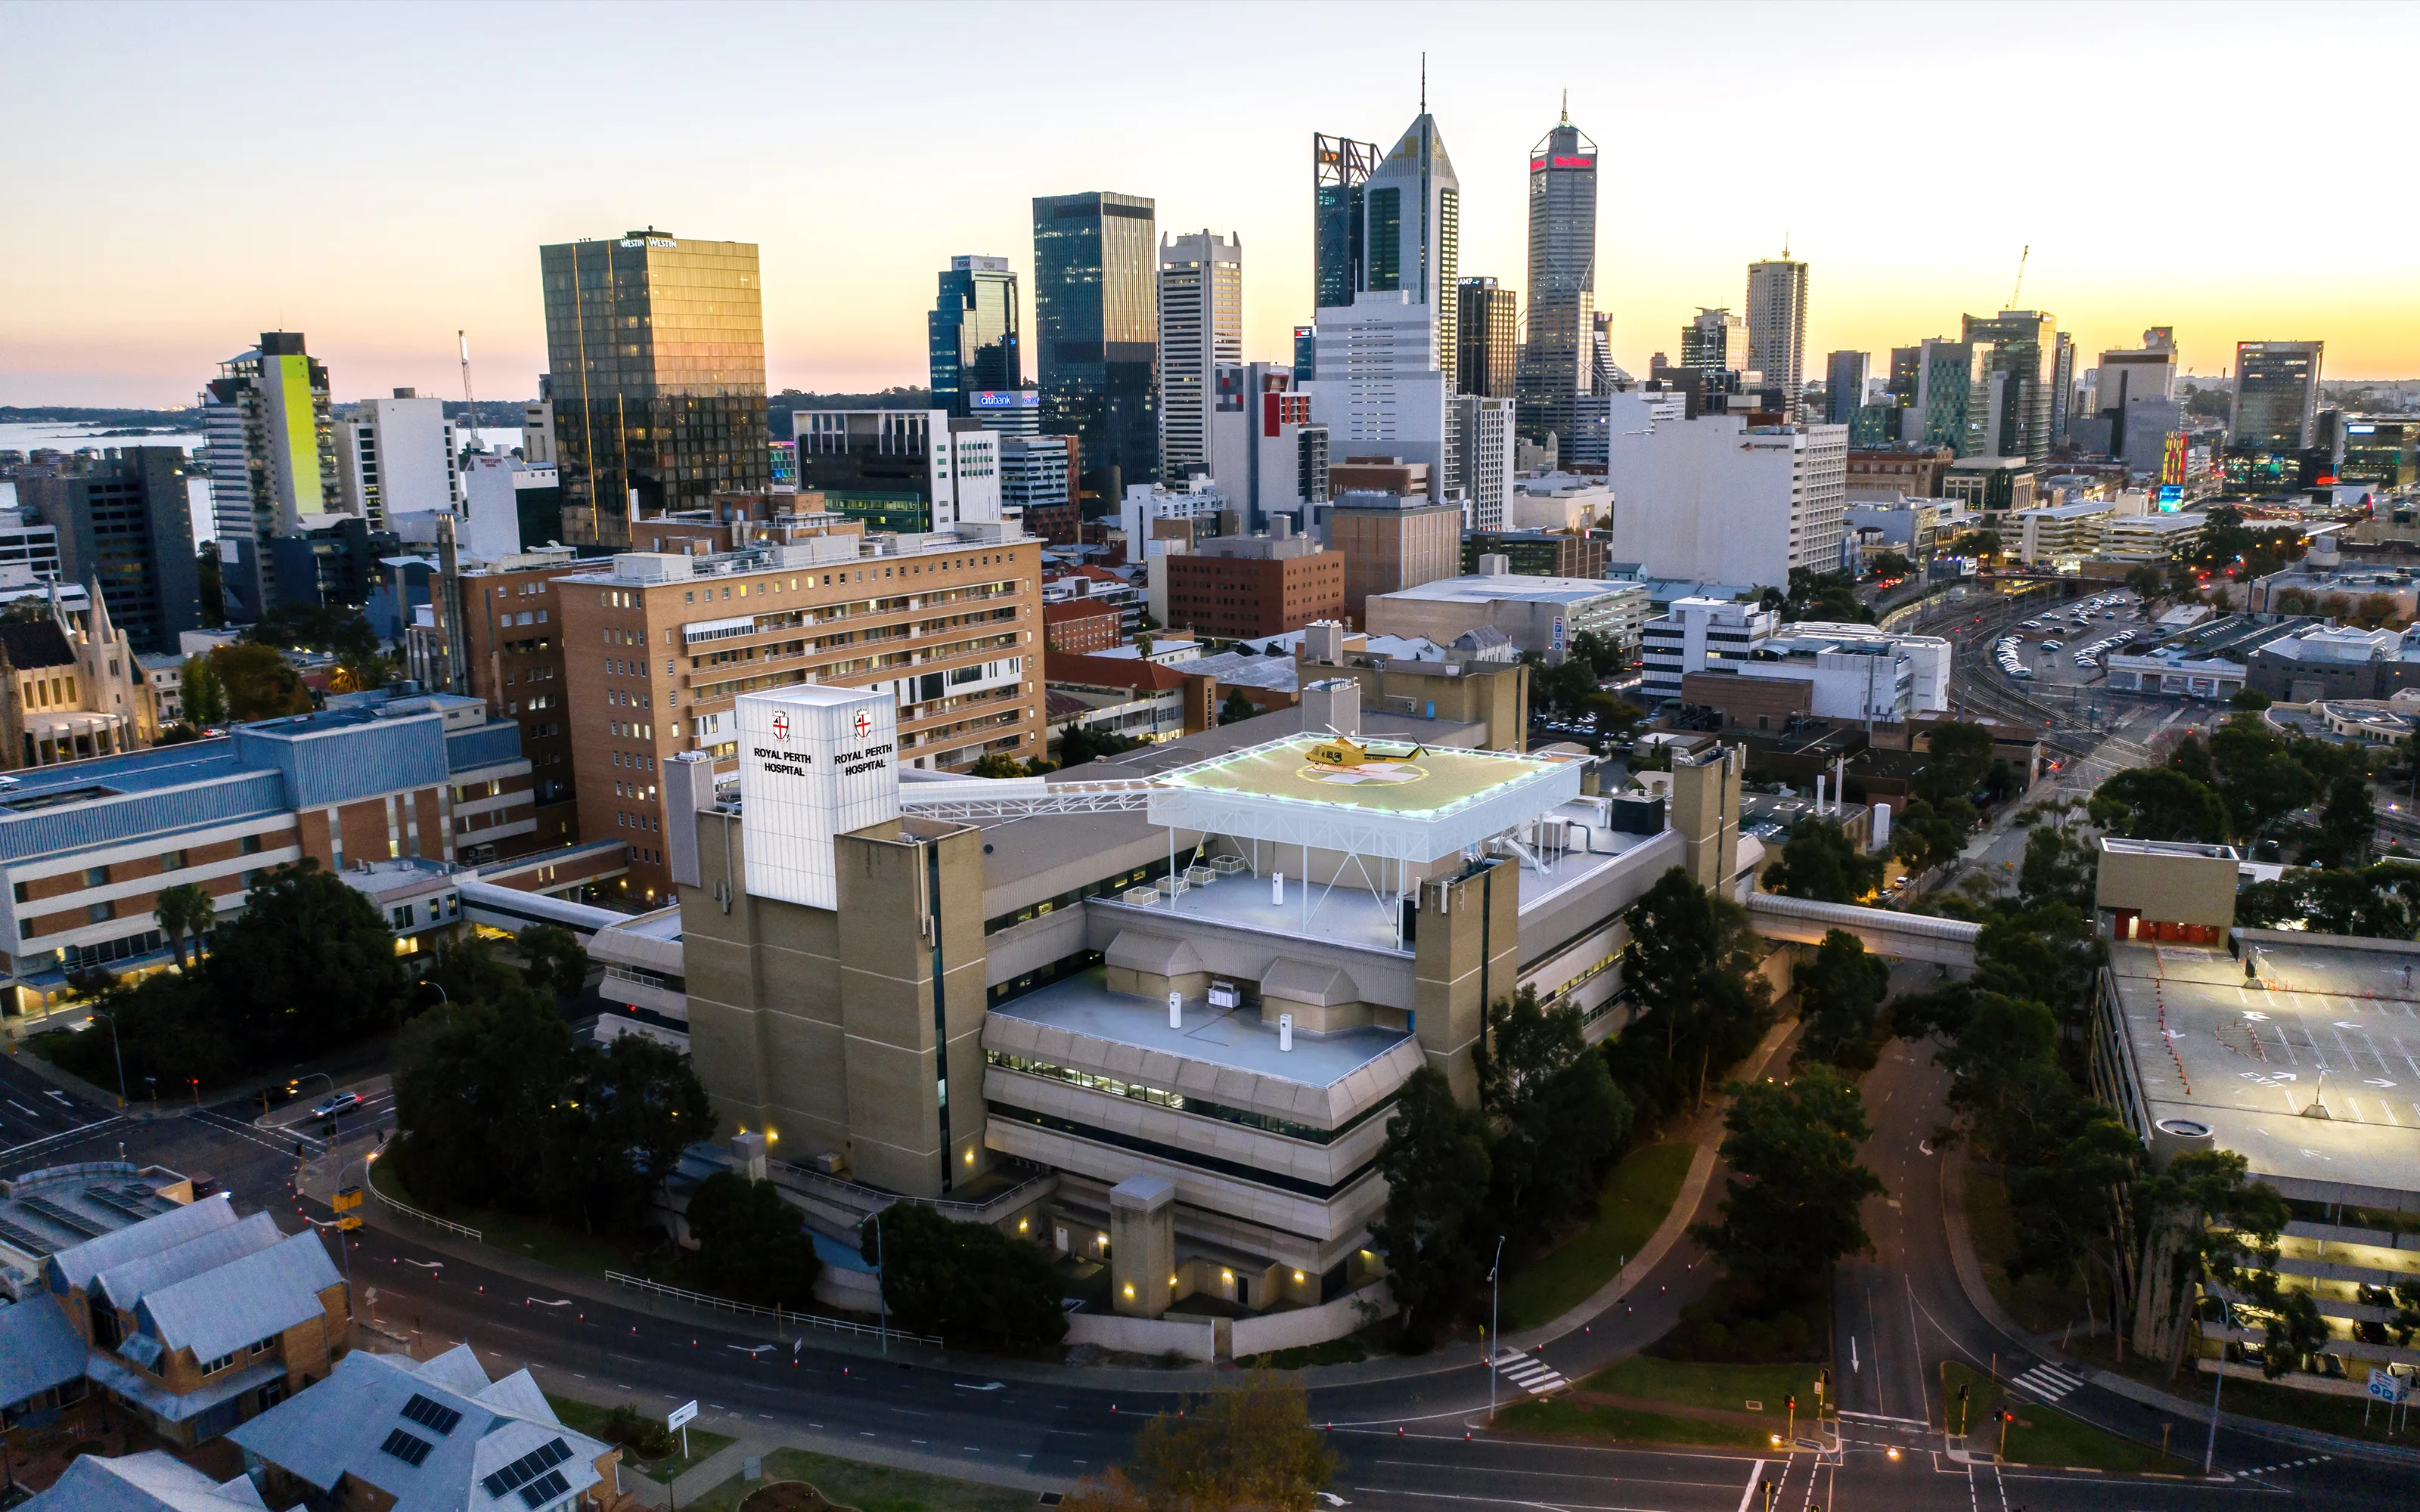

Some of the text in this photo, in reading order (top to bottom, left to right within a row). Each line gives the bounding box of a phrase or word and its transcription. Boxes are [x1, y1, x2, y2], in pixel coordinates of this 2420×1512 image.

[1325, 152, 1337, 161] BP
[648, 237, 677, 248] WESTIN
[981, 394, 1011, 404] citibank
[754, 748, 811, 764] ROYAL PERTH
[834, 744, 892, 765] ROYAL PERTH
[765, 762, 805, 776] HOSPITAL
[845, 759, 886, 776] HOSPITAL
[2238, 1071, 2286, 1088] EXIT
